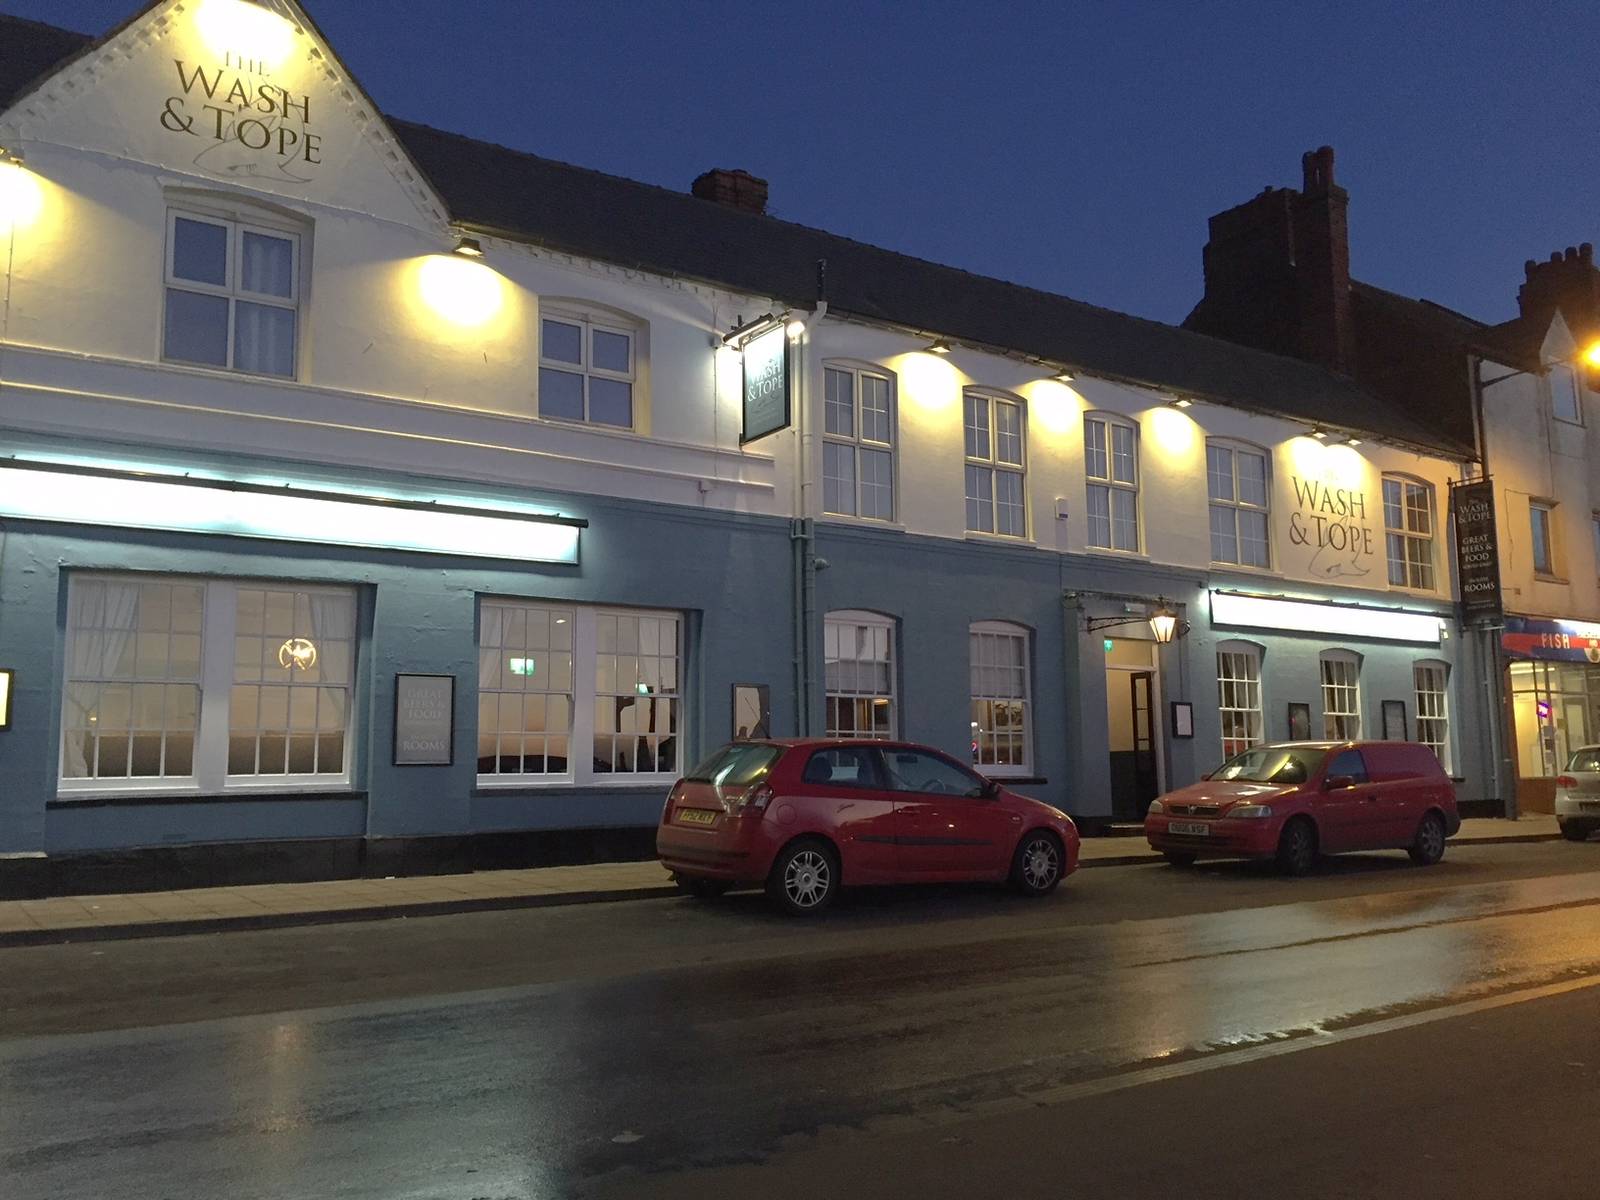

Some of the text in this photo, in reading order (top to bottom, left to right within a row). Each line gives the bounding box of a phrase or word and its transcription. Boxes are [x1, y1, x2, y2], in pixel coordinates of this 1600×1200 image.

[174, 59, 310, 124] WASH
[160, 96, 322, 164] & TOPE
[748, 374, 784, 402] & TOPE
[1292, 476, 1365, 519] WASH
[1459, 503, 1488, 514] WASH
[1289, 512, 1374, 555] & TOPE
[1462, 534, 1488, 545] GREAT
[1465, 552, 1489, 562] FOOD
[1464, 581, 1495, 592] ROOMS
[1541, 632, 1570, 649] FISH
[403, 740, 445, 751] ROOMS
